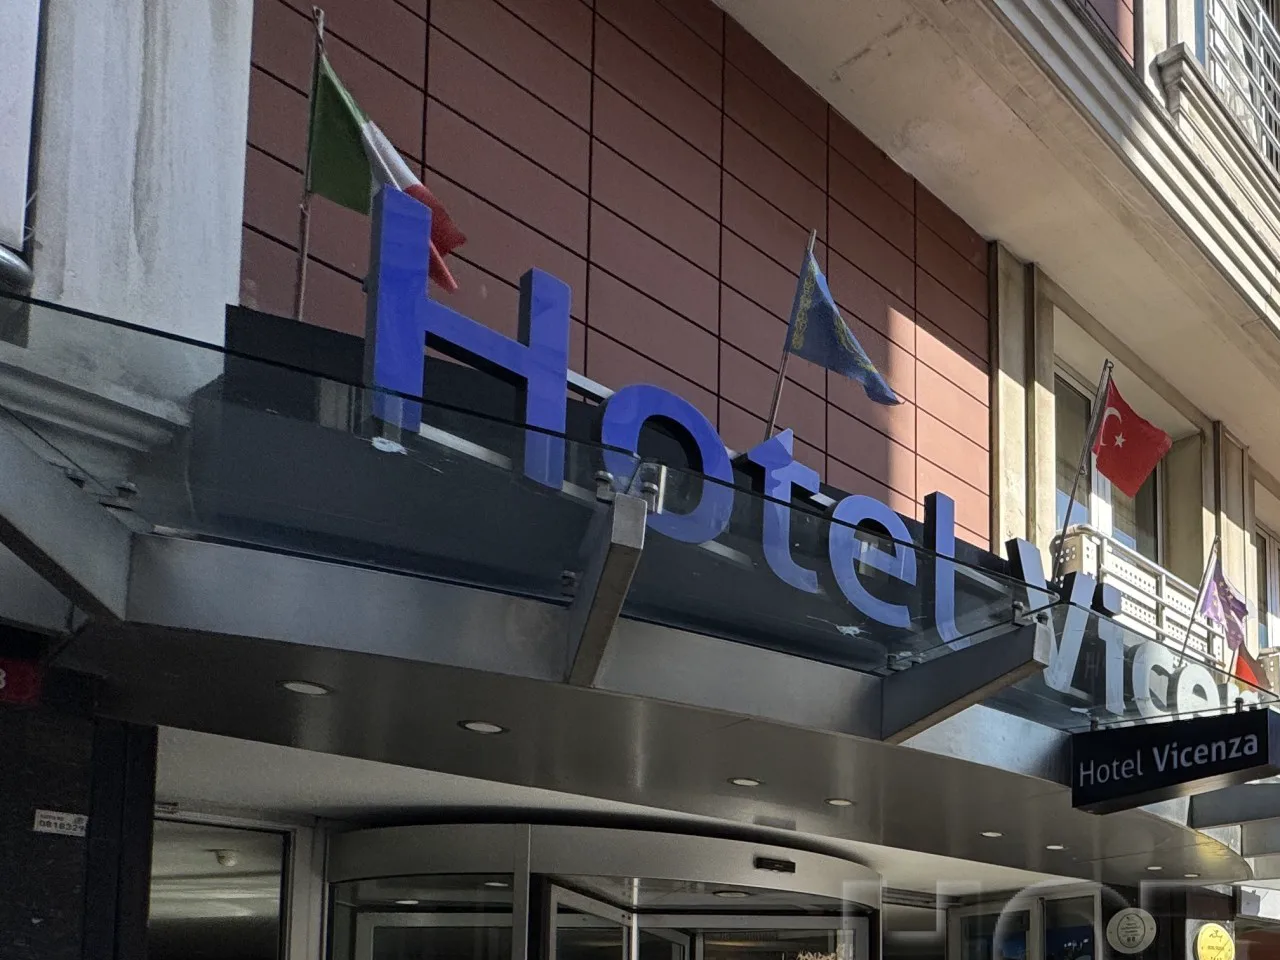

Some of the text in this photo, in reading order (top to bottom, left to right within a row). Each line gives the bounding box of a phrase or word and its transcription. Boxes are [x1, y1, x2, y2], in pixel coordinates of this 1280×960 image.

[363, 183, 971, 650] Hotel
[1079, 733, 1258, 787] Hotel Vicenza
